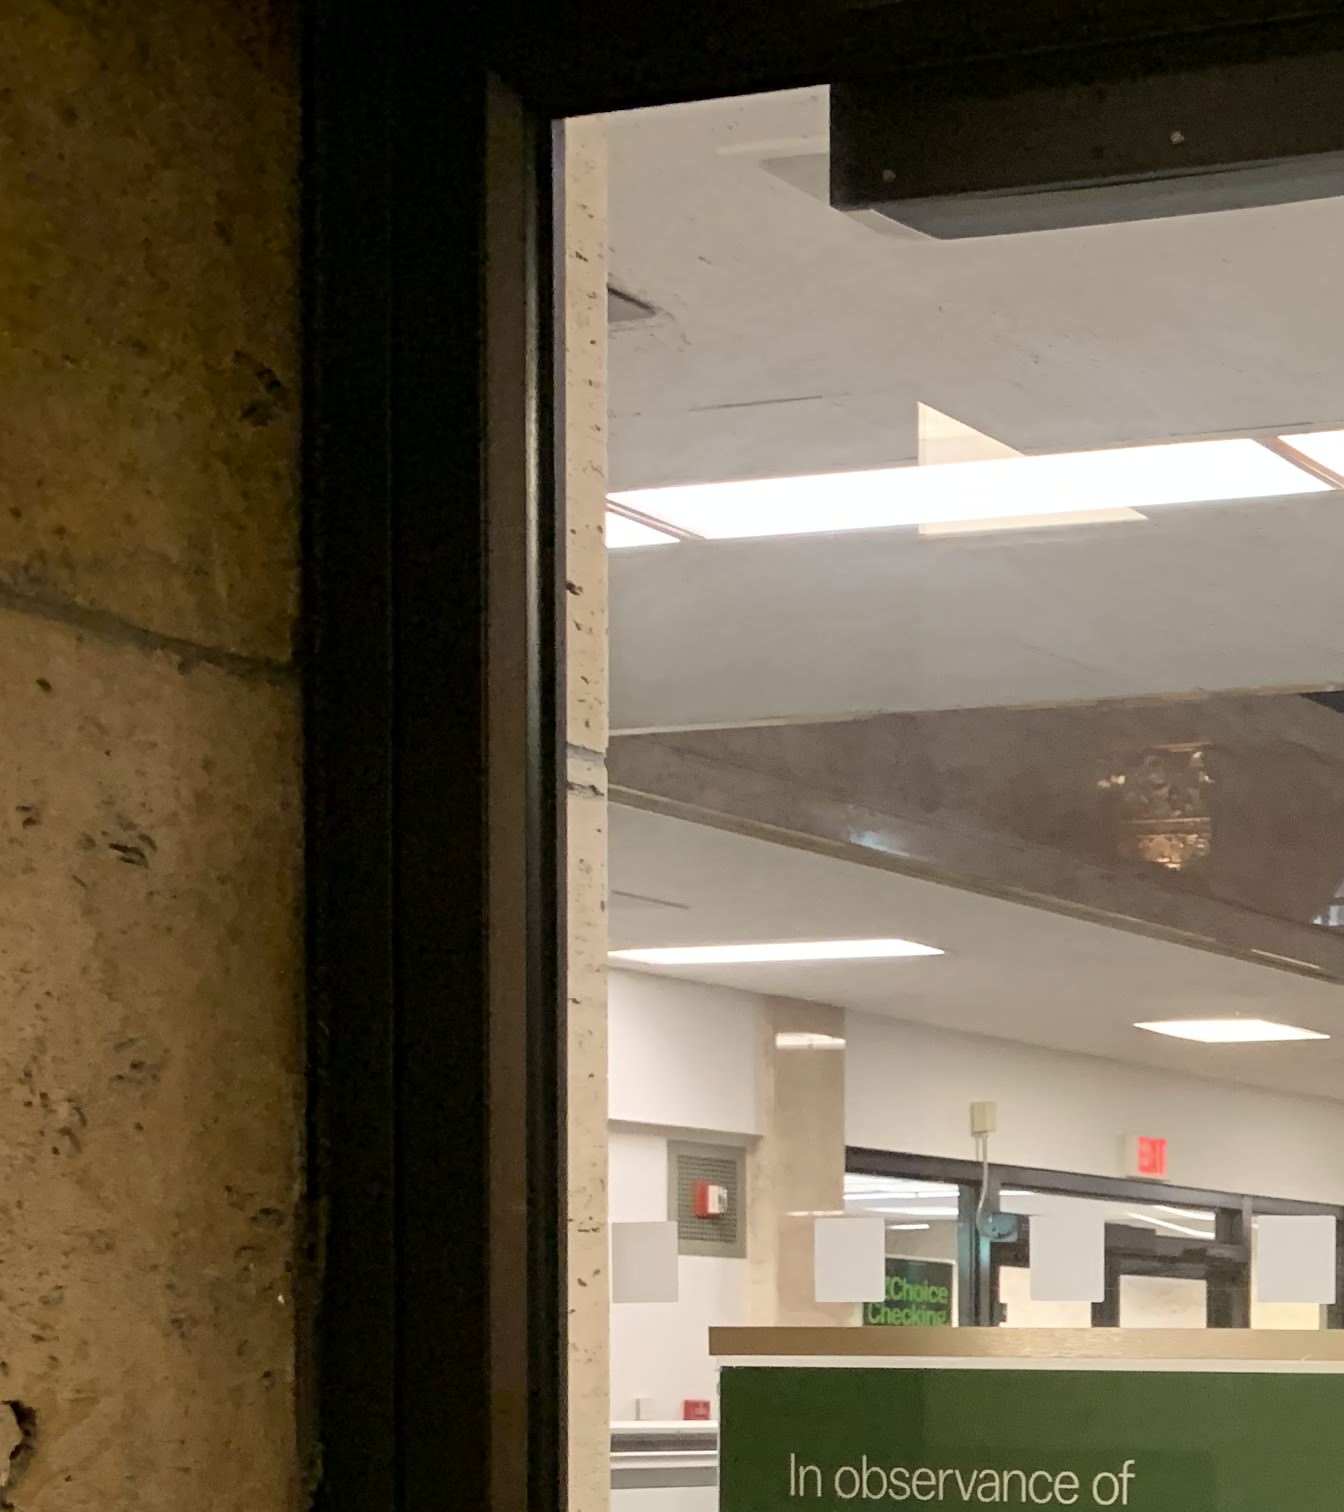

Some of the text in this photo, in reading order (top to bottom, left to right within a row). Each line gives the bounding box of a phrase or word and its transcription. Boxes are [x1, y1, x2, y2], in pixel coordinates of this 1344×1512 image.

[789, 1453, 1136, 1506] In observance of
